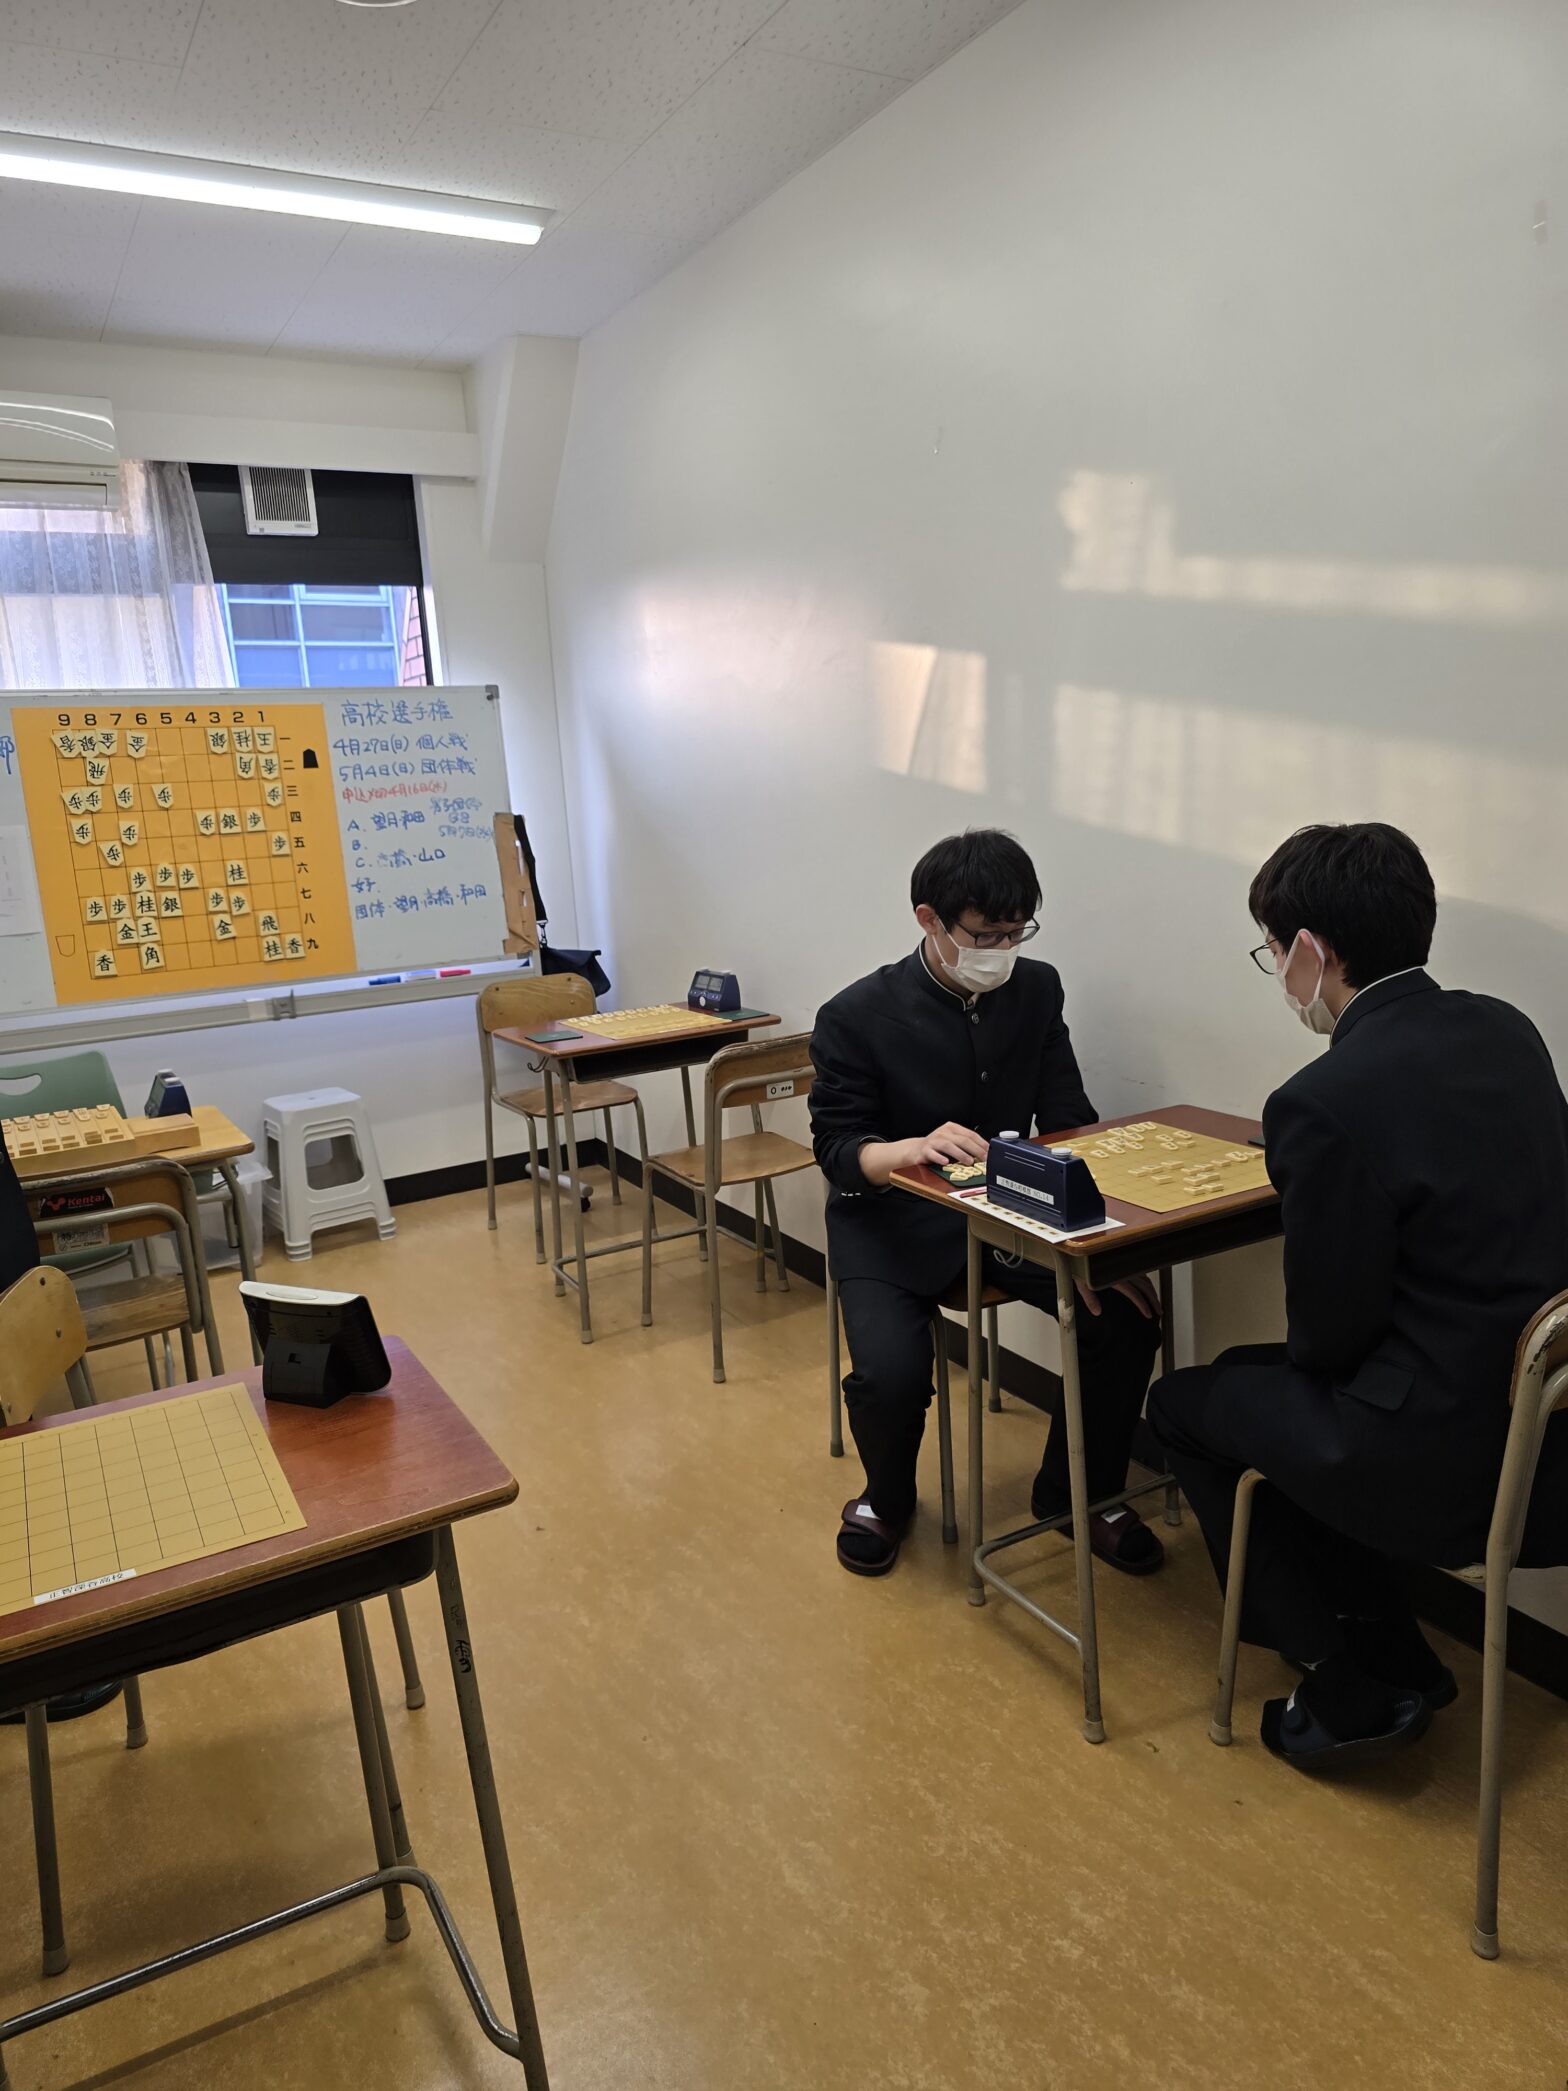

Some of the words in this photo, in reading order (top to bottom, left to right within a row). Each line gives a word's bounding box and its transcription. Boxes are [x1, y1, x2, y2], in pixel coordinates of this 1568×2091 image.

[58, 714, 71, 726] 9
[84, 713, 97, 726] 8
[110, 713, 122, 726] 7
[135, 713, 148, 725] 6
[160, 712, 173, 725] 5
[185, 712, 197, 724] 4
[209, 712, 221, 724] 3
[233, 711, 245, 723] 2
[258, 711, 264, 722] 1
[341, 698, 454, 727] 高校選手権
[99, 732, 116, 749] 金
[128, 735, 145, 752] 金
[209, 732, 227, 748] 銀
[233, 729, 252, 748] 桂
[88, 760, 106, 779] 飛
[239, 756, 253, 774] 角
[261, 758, 278, 774] 香
[283, 760, 295, 770] 二
[117, 787, 132, 804] 歩
[157, 786, 171, 803] 歩
[267, 786, 280, 801] 歩
[286, 785, 298, 796] 三
[68, 792, 83, 810] 歩
[86, 791, 100, 807] 歩
[200, 814, 214, 830] 歩
[221, 813, 239, 829] 銀
[248, 812, 261, 828] 歩
[290, 811, 302, 822] 四
[75, 822, 91, 840] 歩
[122, 824, 137, 840] 歩
[273, 835, 286, 851] 歩
[294, 837, 305, 848] 五
[106, 844, 120, 861] 歩
[158, 867, 173, 883] 歩
[181, 868, 194, 884] 歩
[228, 864, 246, 882] 桂
[296, 862, 309, 874] 六
[132, 872, 147, 889] 歩
[210, 892, 224, 908] 歩
[300, 888, 312, 899] 七
[88, 901, 103, 918] 歩
[112, 898, 127, 915] 歩
[137, 896, 155, 914] 桂
[162, 896, 180, 913] 銀
[232, 895, 245, 911] 歩
[261, 915, 278, 932] 飛
[304, 913, 316, 924] 八
[118, 923, 136, 940] 金
[141, 922, 157, 938] 王
[217, 919, 232, 936] 金
[264, 940, 282, 958] 桂
[287, 937, 302, 954] 香
[306, 939, 319, 949] 九
[96, 954, 113, 972] 香
[145, 946, 160, 965] 角
[68, 1194, 105, 1206] Kentai
